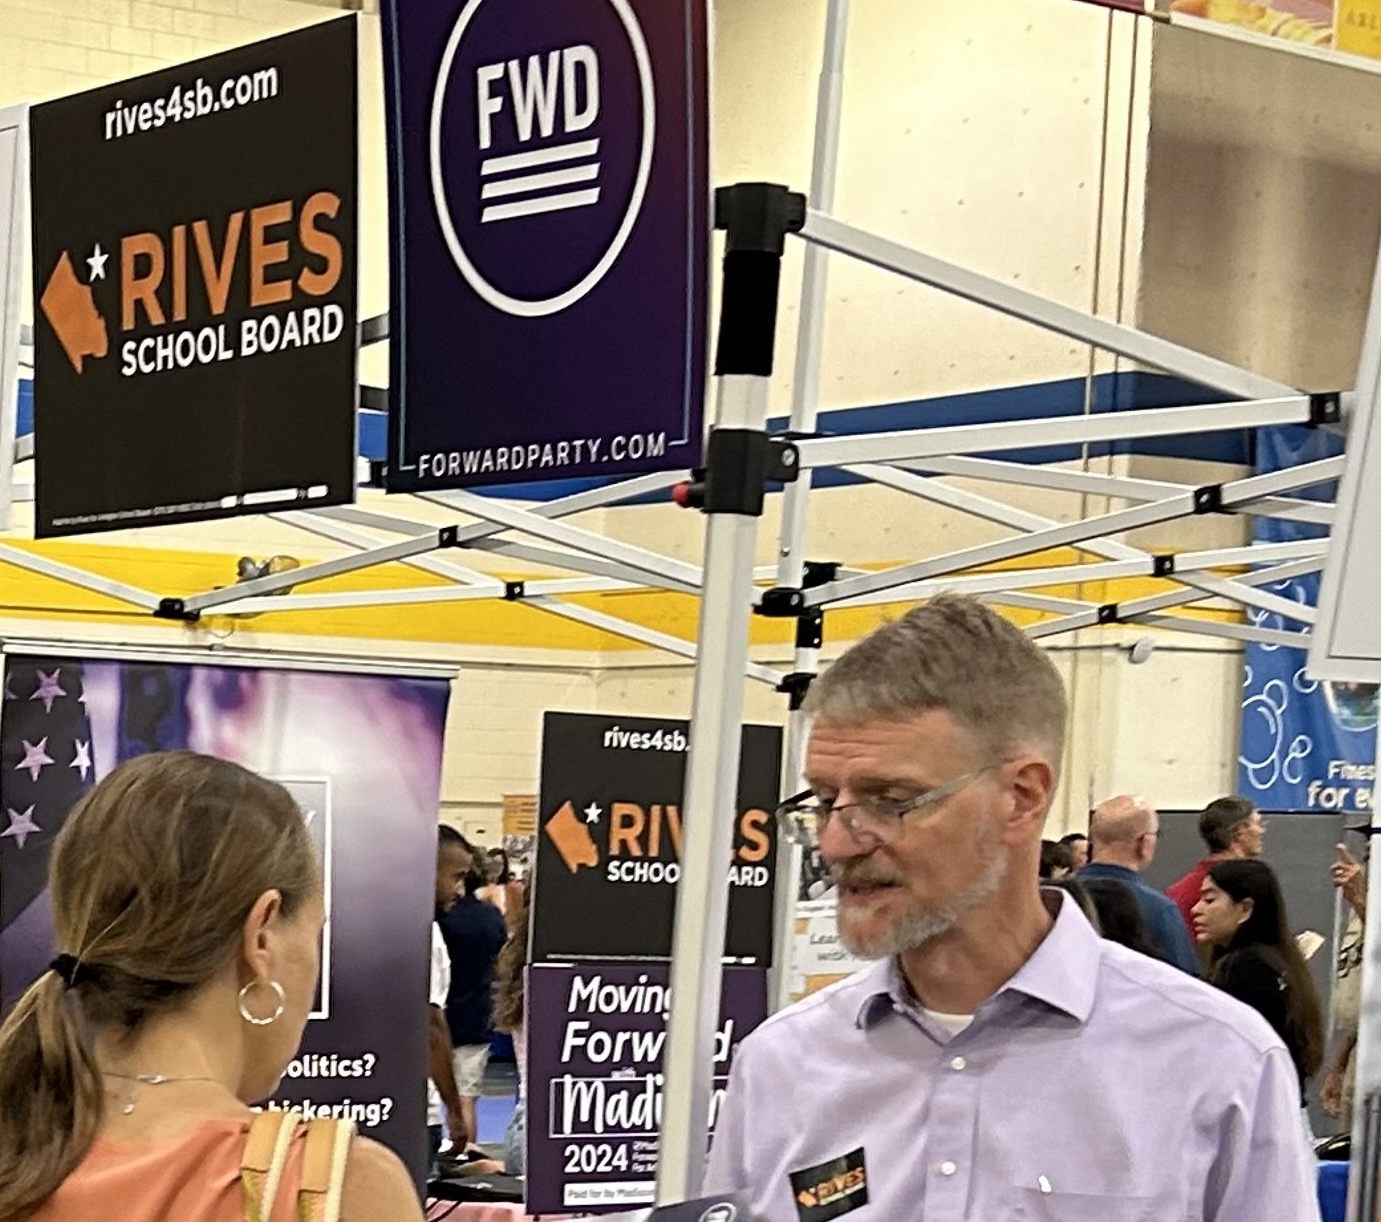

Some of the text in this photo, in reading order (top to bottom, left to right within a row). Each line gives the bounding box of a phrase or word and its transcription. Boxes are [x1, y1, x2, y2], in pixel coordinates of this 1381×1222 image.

[105, 66, 279, 140] rives4sb.com
[477, 44, 600, 150] FWD
[120, 191, 344, 333] RIVES
[120, 303, 345, 378] SCHOOL BOARD
[417, 432, 666, 478] FORWARDPARTY.COM
[604, 725, 691, 751] rives4sb.
[1307, 779, 1350, 809] for
[607, 860, 769, 887] SCHOO ARD
[561, 1019, 734, 1063] Forwd
[280, 1053, 376, 1078] olitics?
[564, 1143, 628, 1173] 2024
